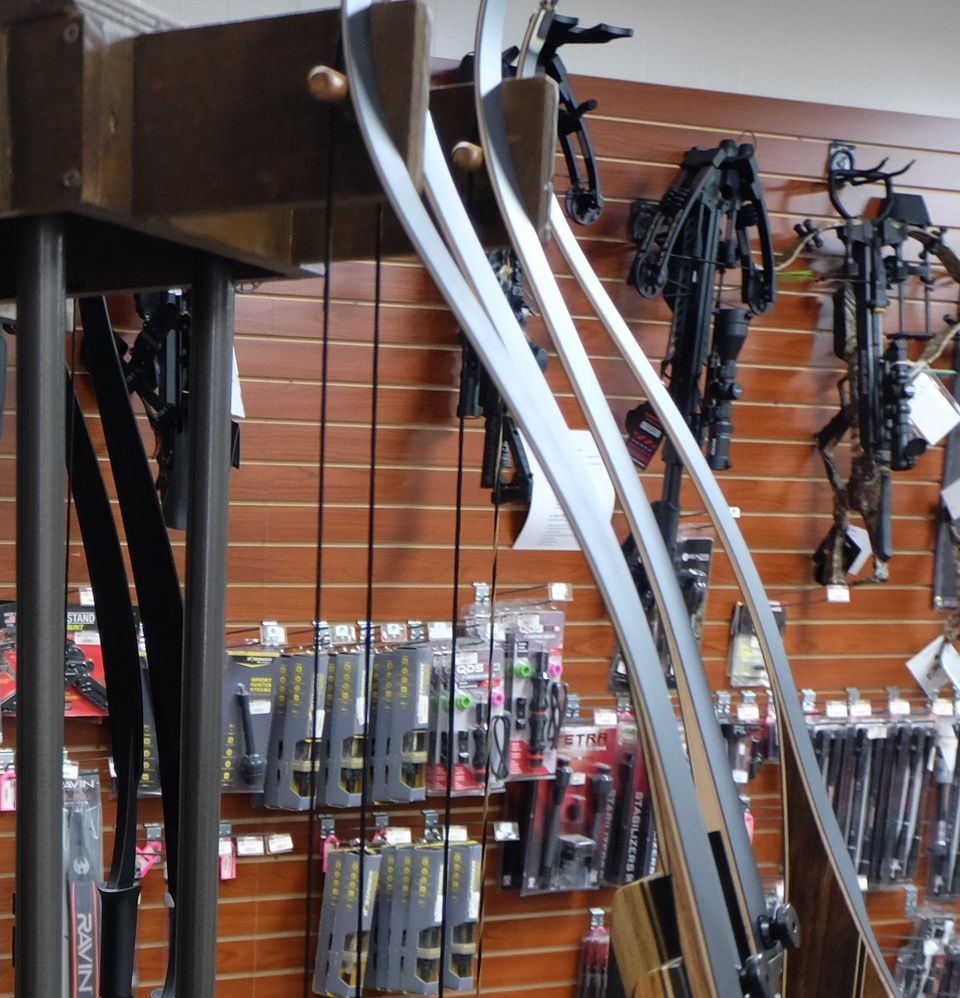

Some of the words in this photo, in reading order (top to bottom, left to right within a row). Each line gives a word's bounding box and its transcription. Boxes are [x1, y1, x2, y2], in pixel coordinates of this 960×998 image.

[67, 614, 95, 624] STAND
[625, 791, 644, 875] STABILIZERS
[77, 913, 93, 992] RAVIN
